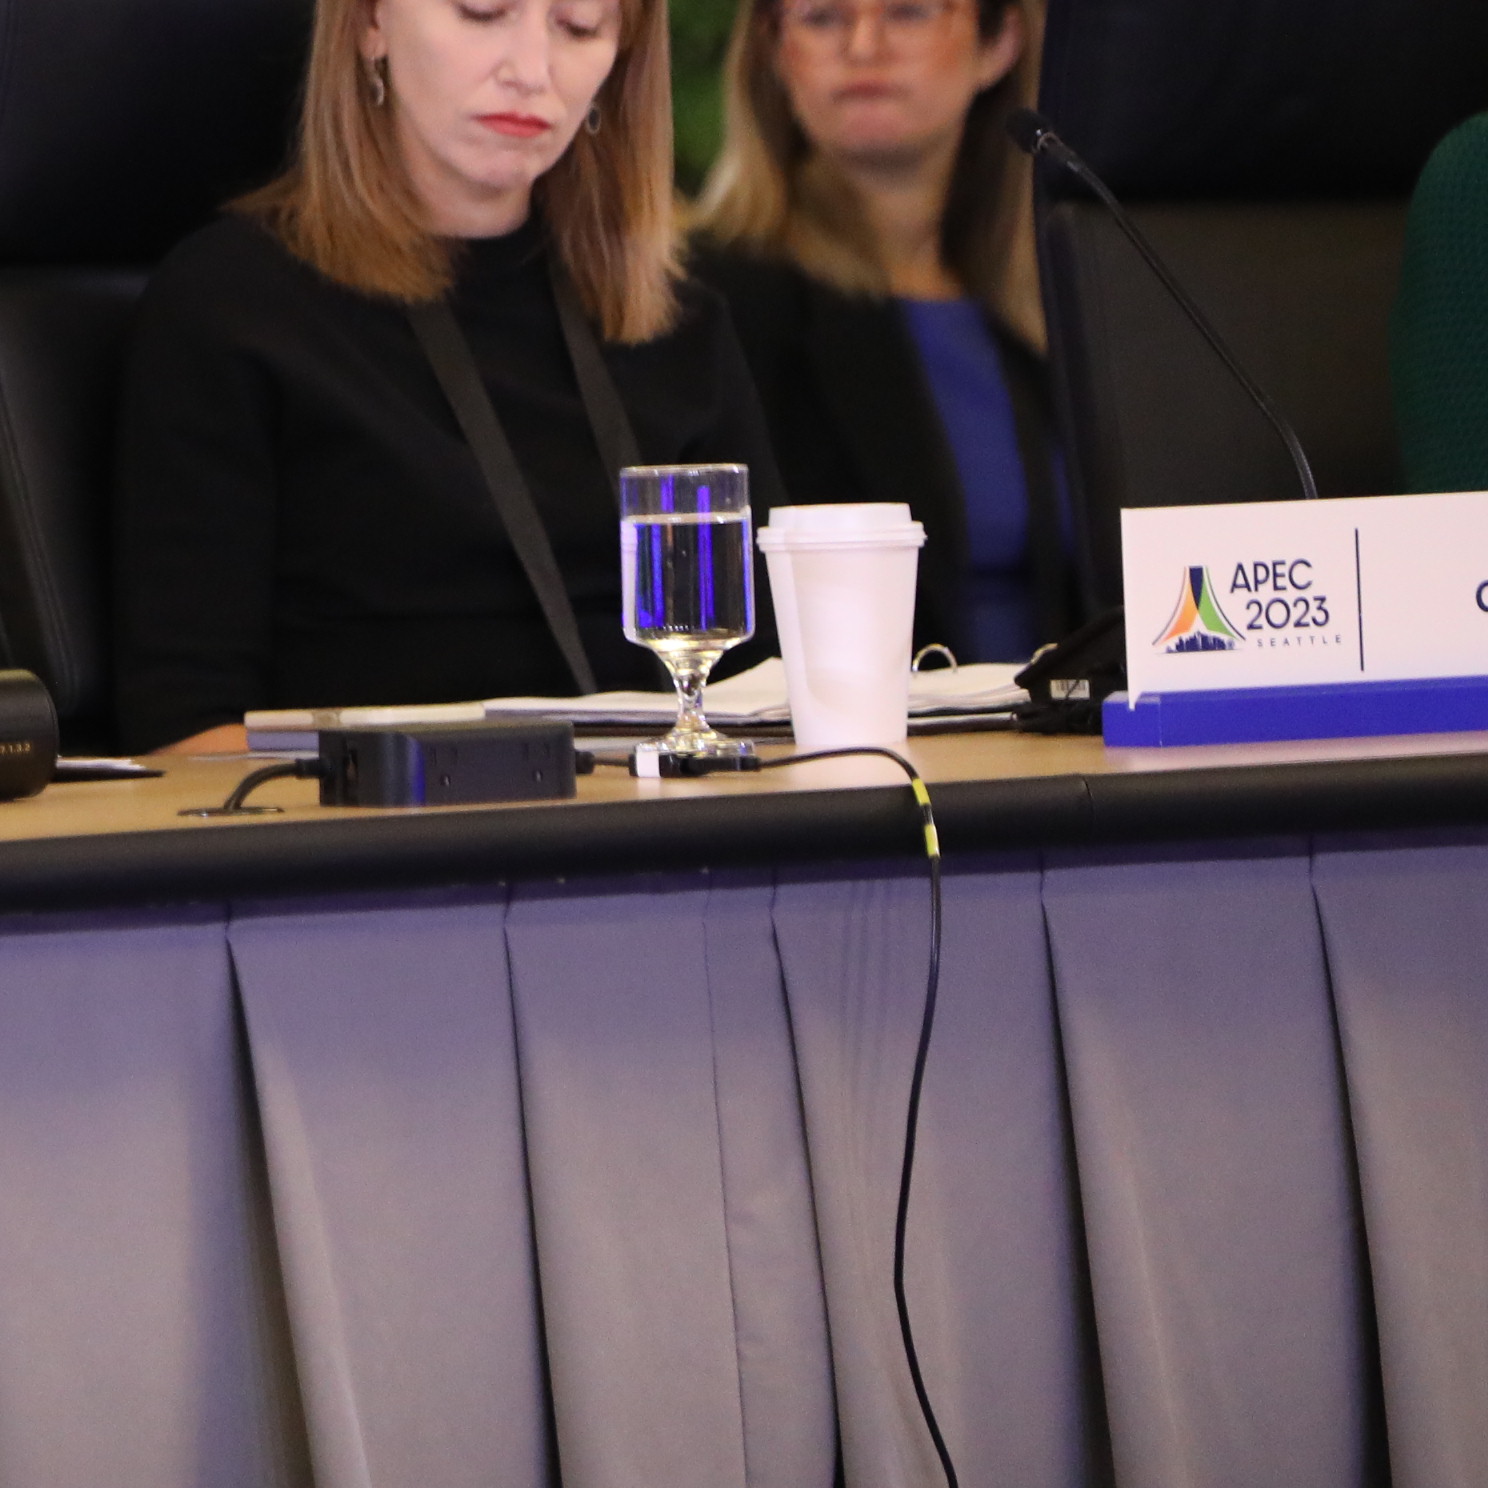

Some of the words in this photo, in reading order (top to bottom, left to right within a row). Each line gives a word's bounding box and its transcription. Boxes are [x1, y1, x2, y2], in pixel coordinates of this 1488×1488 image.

[1229, 558, 1313, 594] APEC
[1245, 595, 1330, 630] 2023
[1256, 634, 1342, 648] SEATTLE
